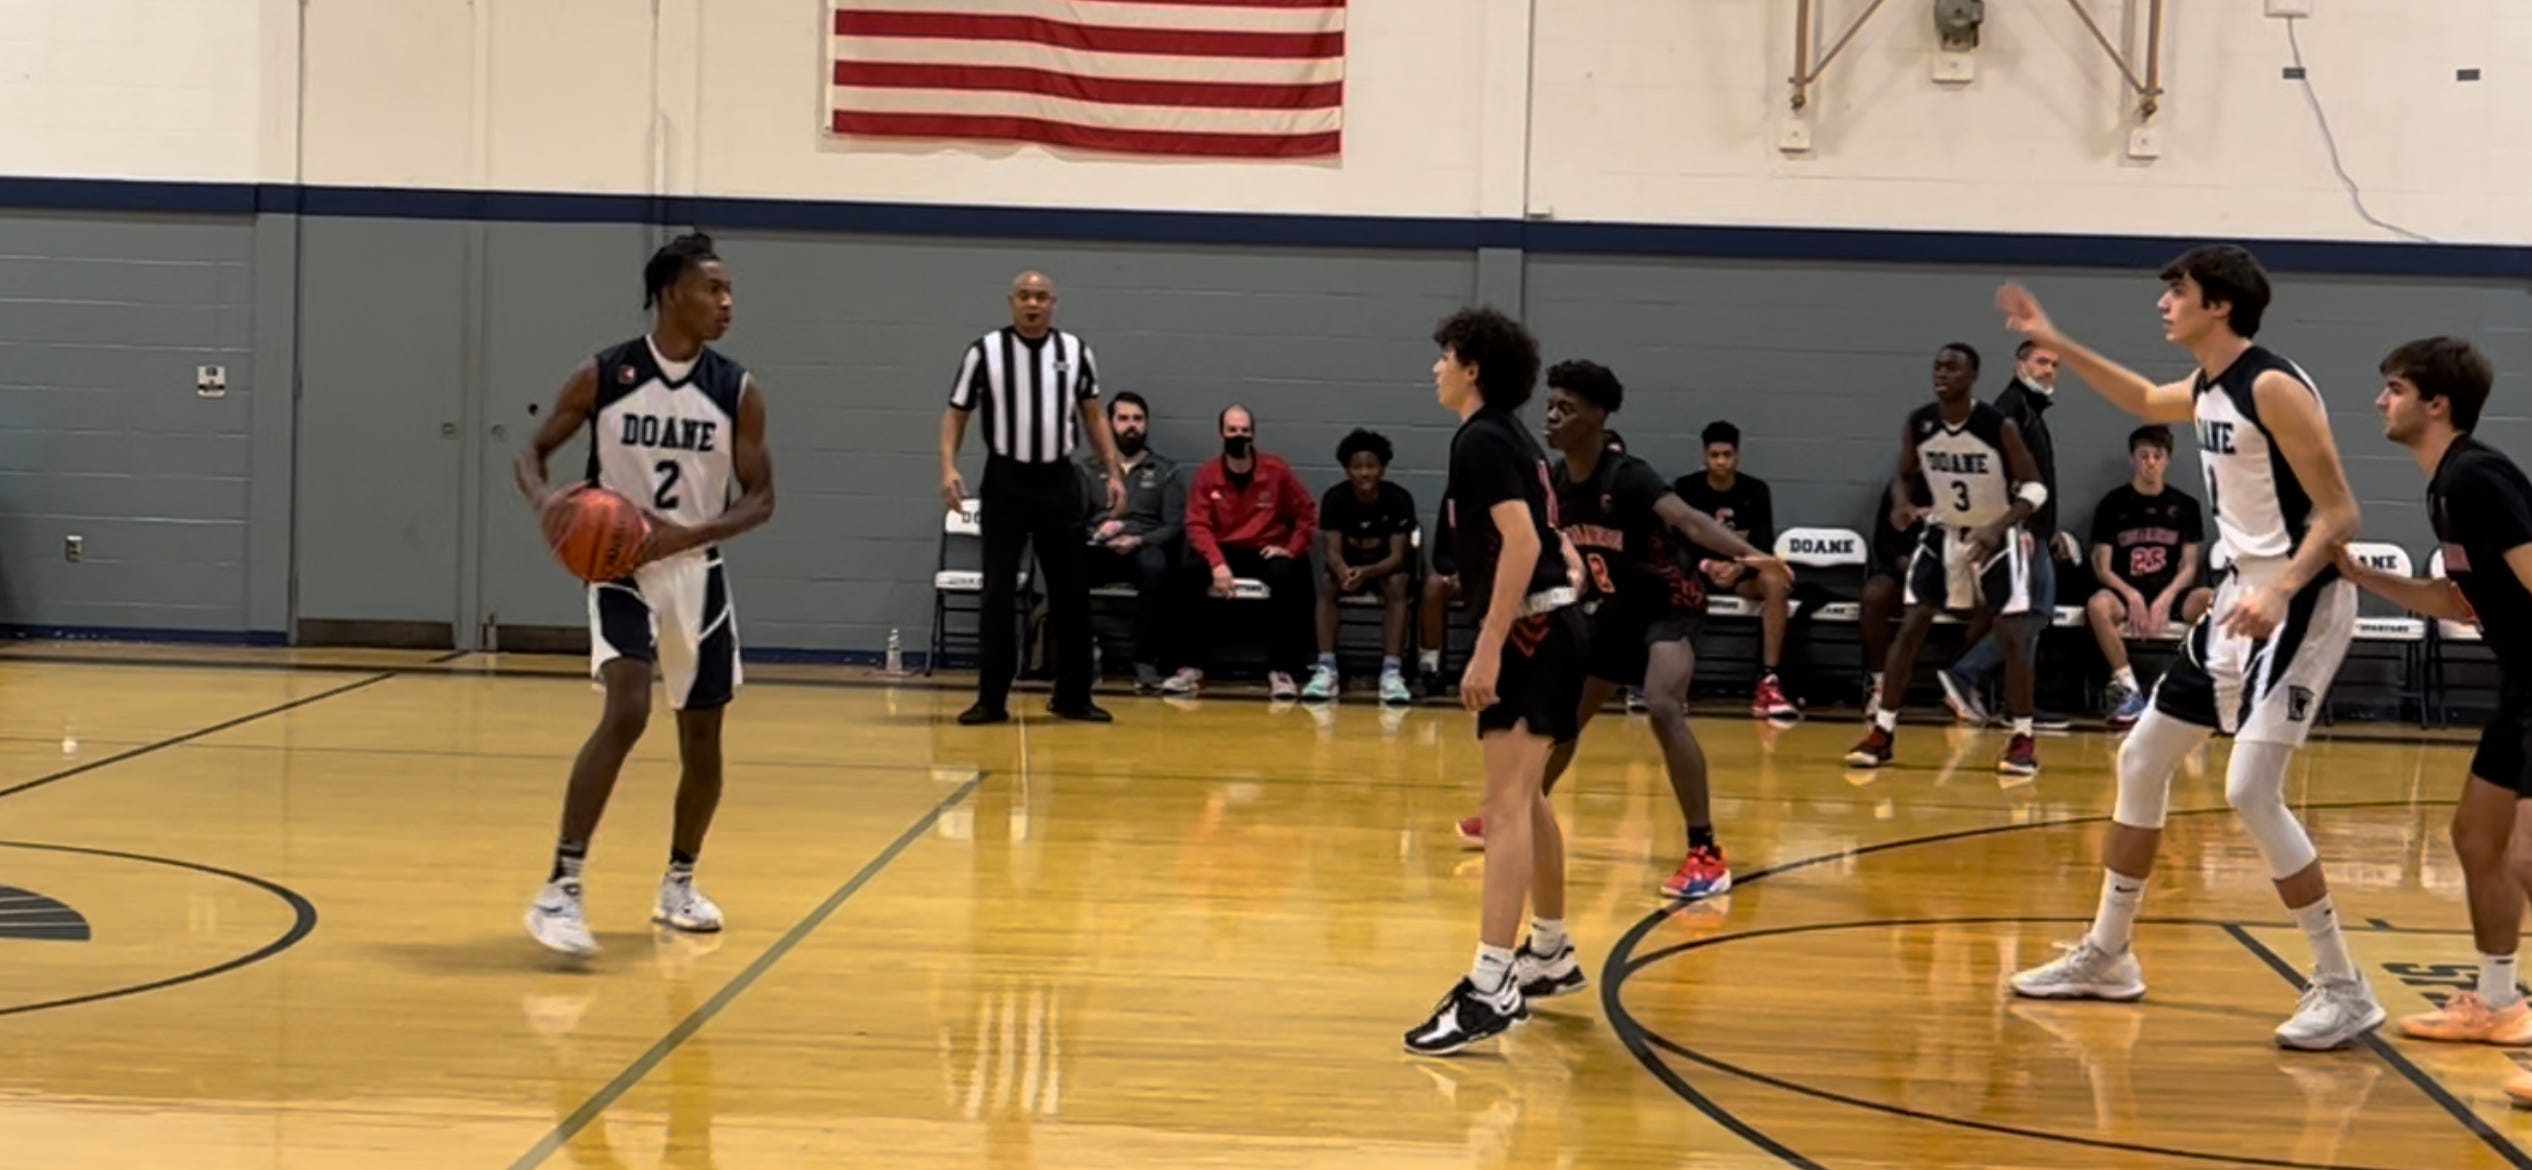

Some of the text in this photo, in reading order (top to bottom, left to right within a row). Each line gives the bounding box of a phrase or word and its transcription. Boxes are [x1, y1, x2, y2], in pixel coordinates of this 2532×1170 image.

[621, 412, 717, 452] DOANE
[1926, 451, 1990, 474] DOANE
[655, 459, 680, 510] 2
[1951, 481, 1970, 511] 3
[1788, 537, 1855, 554] DOANE
